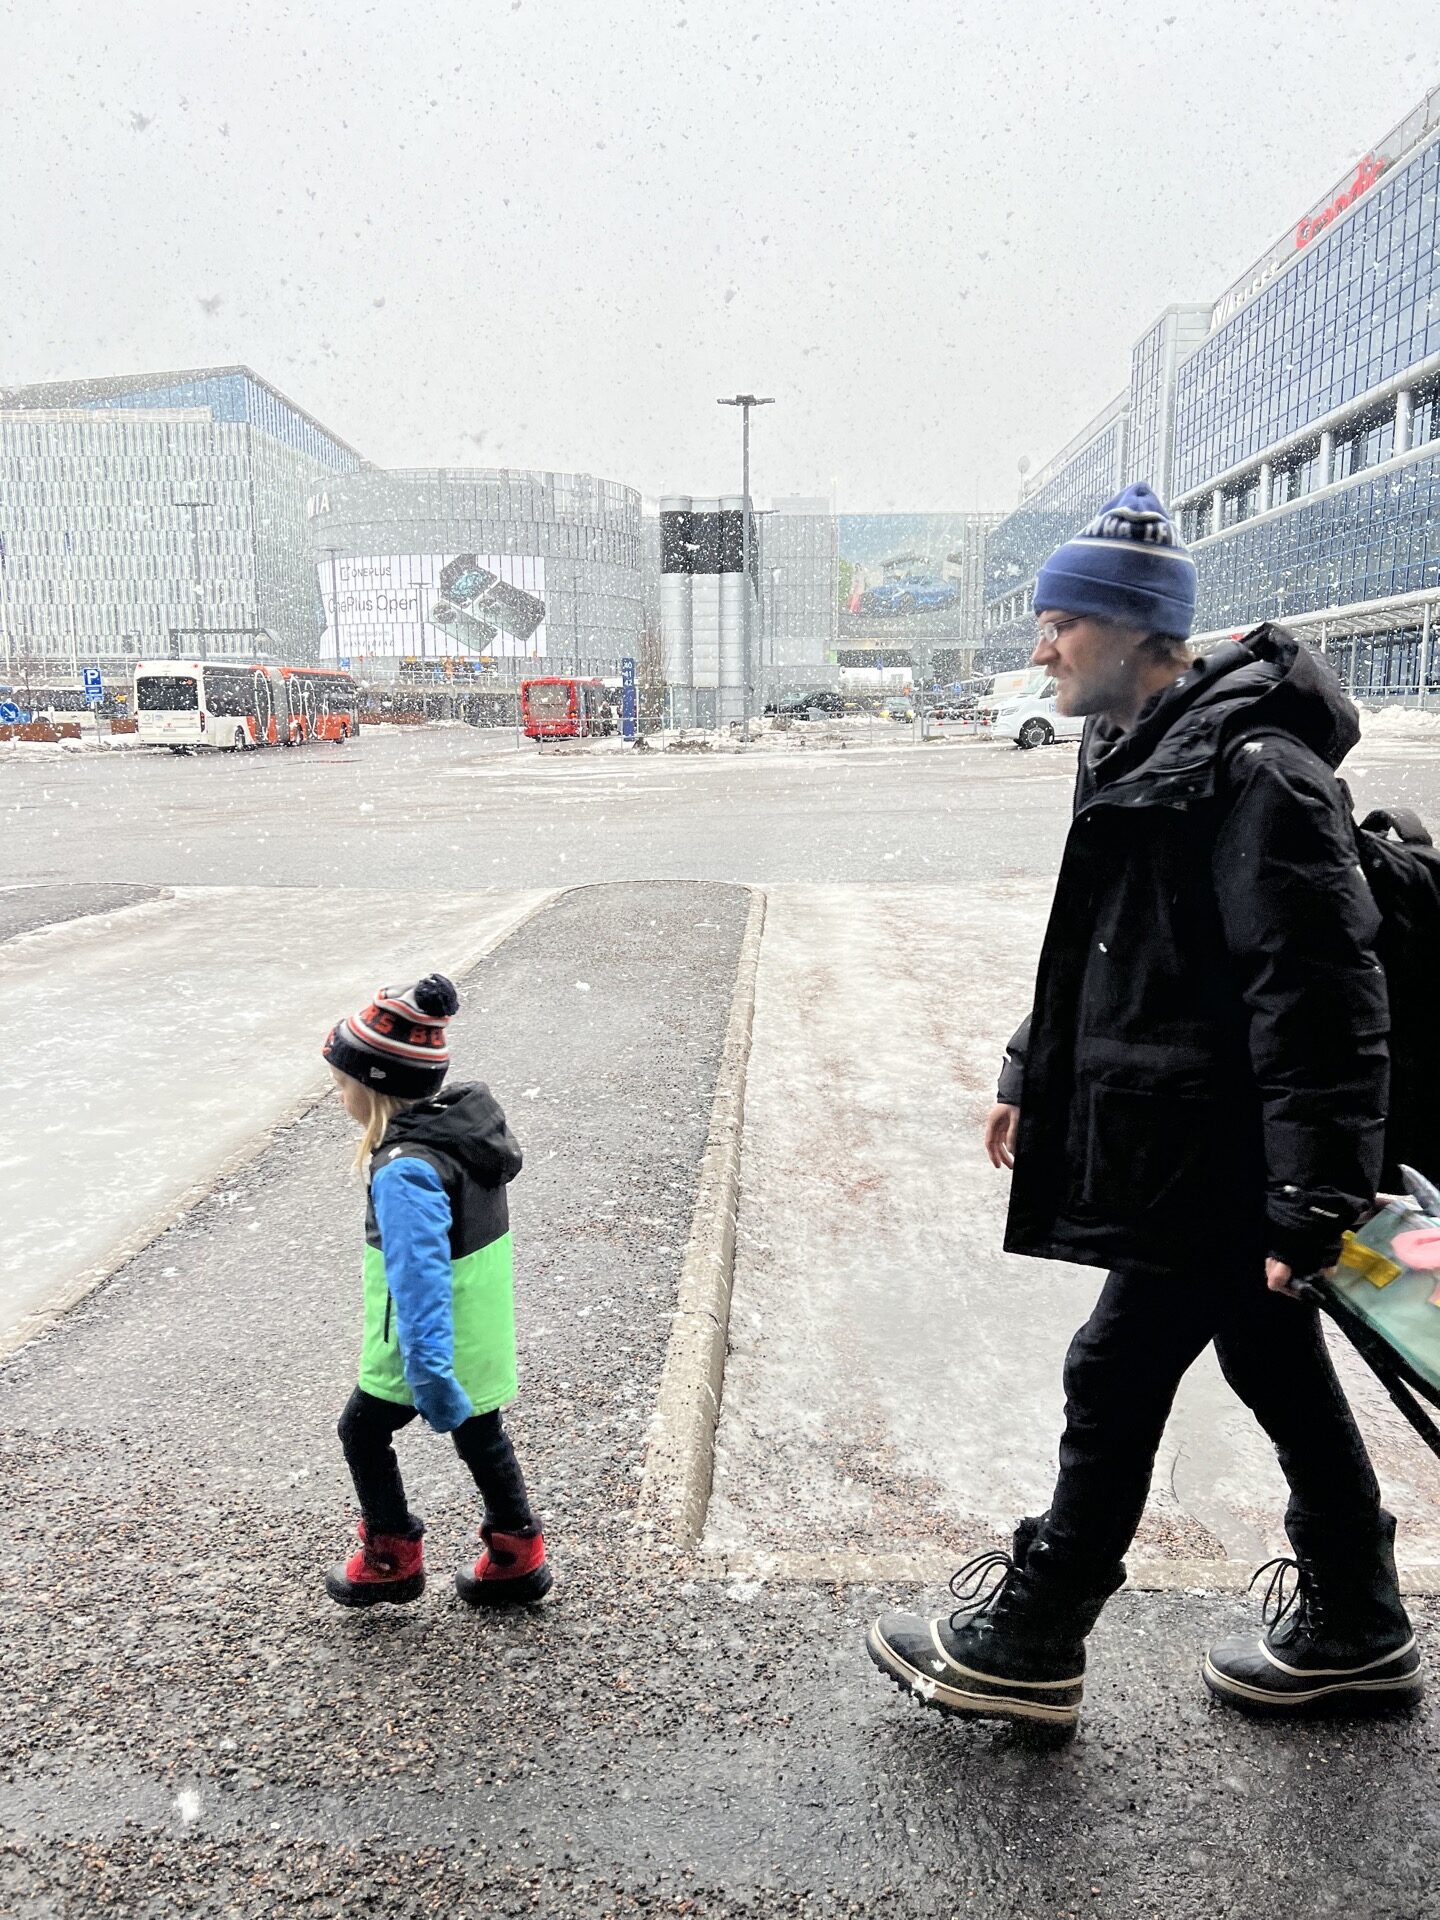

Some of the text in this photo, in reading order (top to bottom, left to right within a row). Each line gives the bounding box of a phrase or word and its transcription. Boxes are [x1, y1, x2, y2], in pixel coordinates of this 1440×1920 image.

[351, 567, 392, 578] ONEPLUS
[328, 595, 418, 614] OnePlus Open
[86, 669, 99, 685] P
[624, 679, 633, 687] 42
